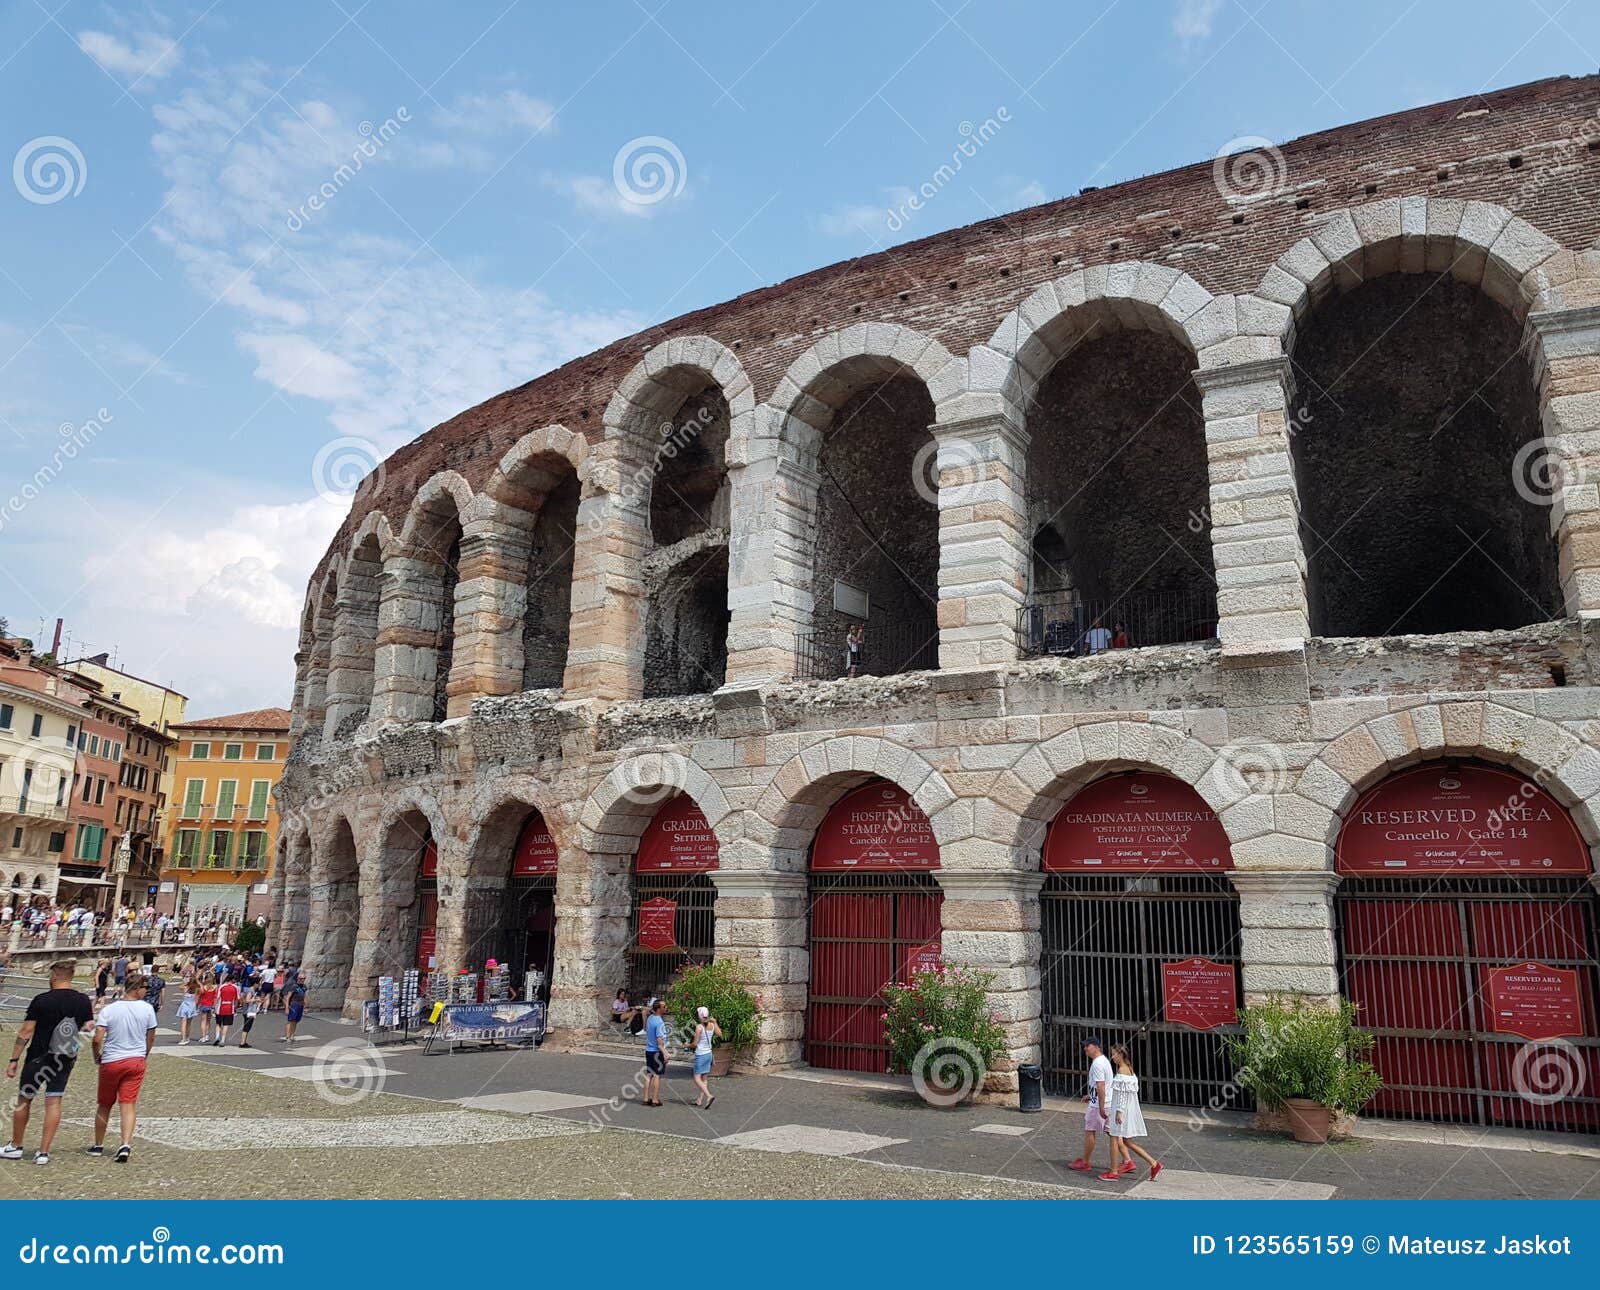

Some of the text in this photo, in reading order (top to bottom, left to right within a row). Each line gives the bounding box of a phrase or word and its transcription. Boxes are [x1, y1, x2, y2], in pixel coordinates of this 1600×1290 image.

[1067, 812, 1140, 824] GRADINATA
[1361, 808, 1552, 825] RESERVED AREA
[662, 819, 709, 832] GRADIN
[842, 823, 889, 835] STAMPA
[1165, 824, 1191, 832] SEATS
[849, 837, 887, 845] Cancello
[896, 836, 918, 844] Gate
[919, 835, 931, 844] 12
[1098, 835, 1135, 844] Entrata
[1147, 834, 1172, 843] Gate
[1385, 828, 1450, 841] Cancello
[1468, 828, 1505, 840] Gate
[1510, 827, 1528, 839] 14
